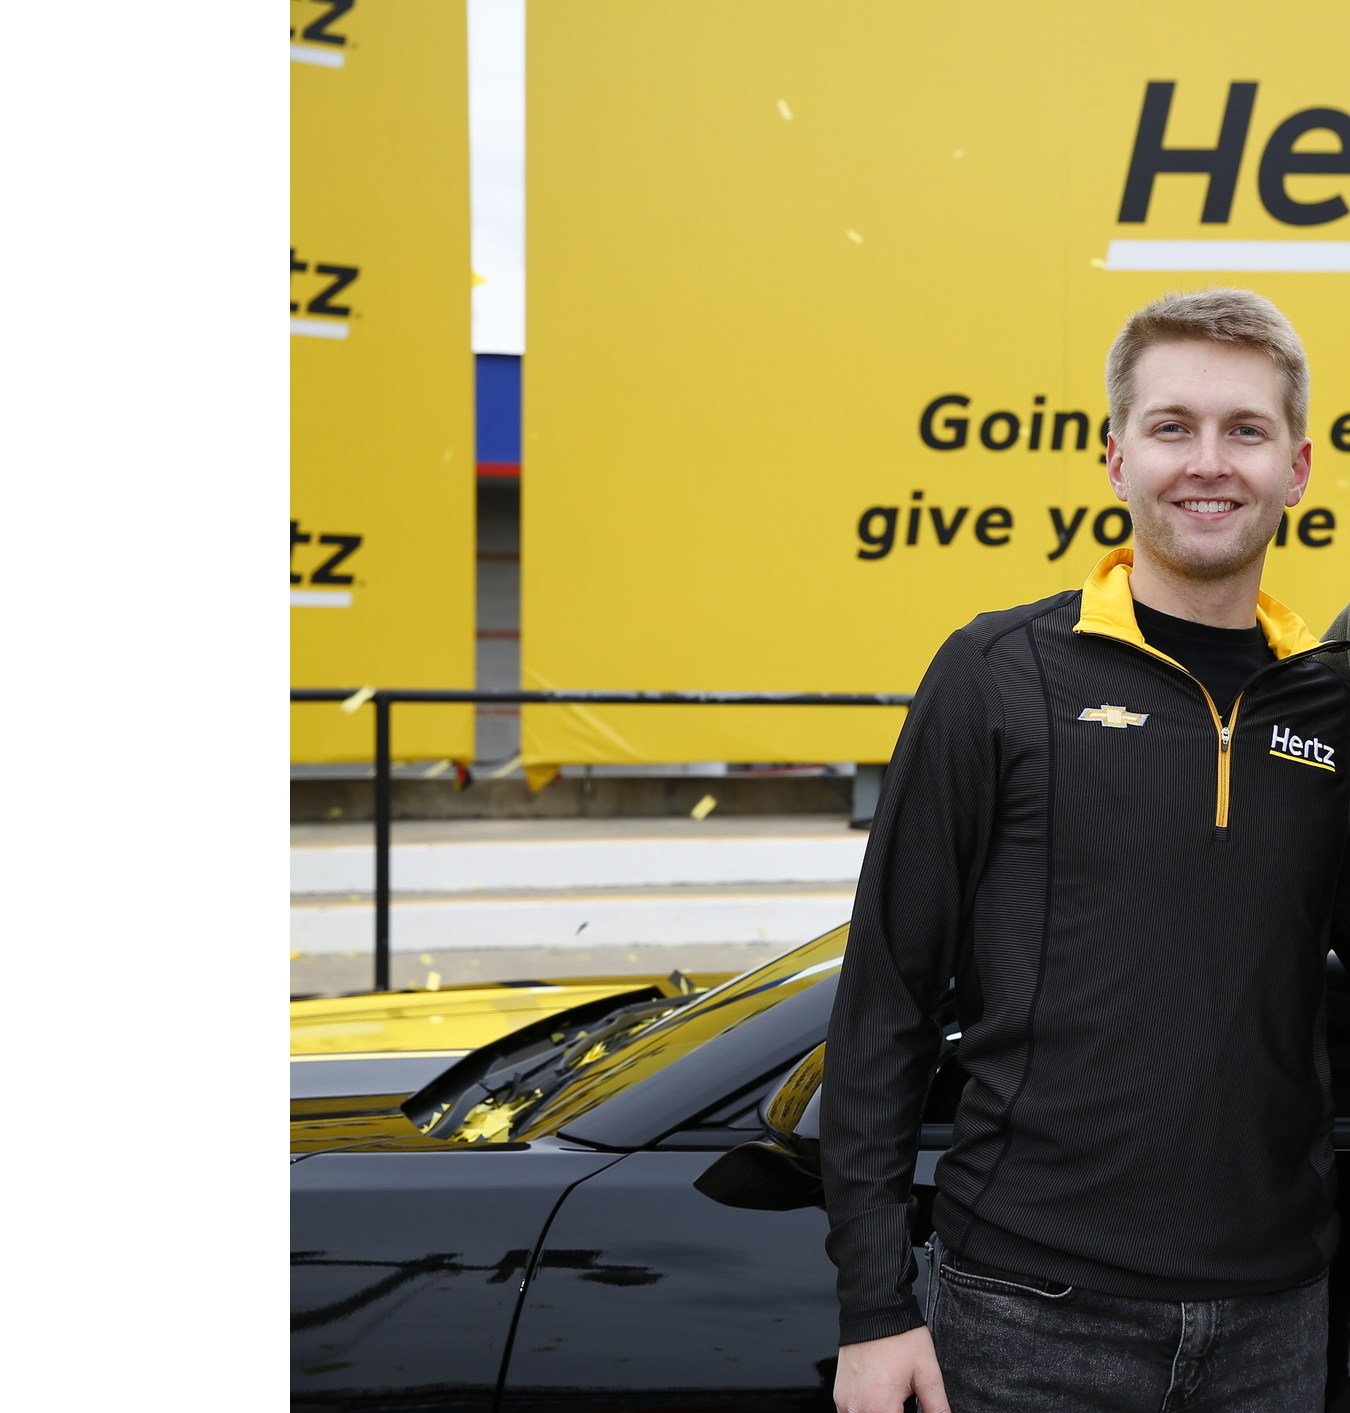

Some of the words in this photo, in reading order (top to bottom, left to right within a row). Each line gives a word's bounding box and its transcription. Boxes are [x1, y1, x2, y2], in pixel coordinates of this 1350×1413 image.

[918, 393, 1110, 465] Goin
[856, 490, 1014, 561] give
[1046, 505, 1134, 561] yo
[1270, 724, 1336, 767] Hertz
